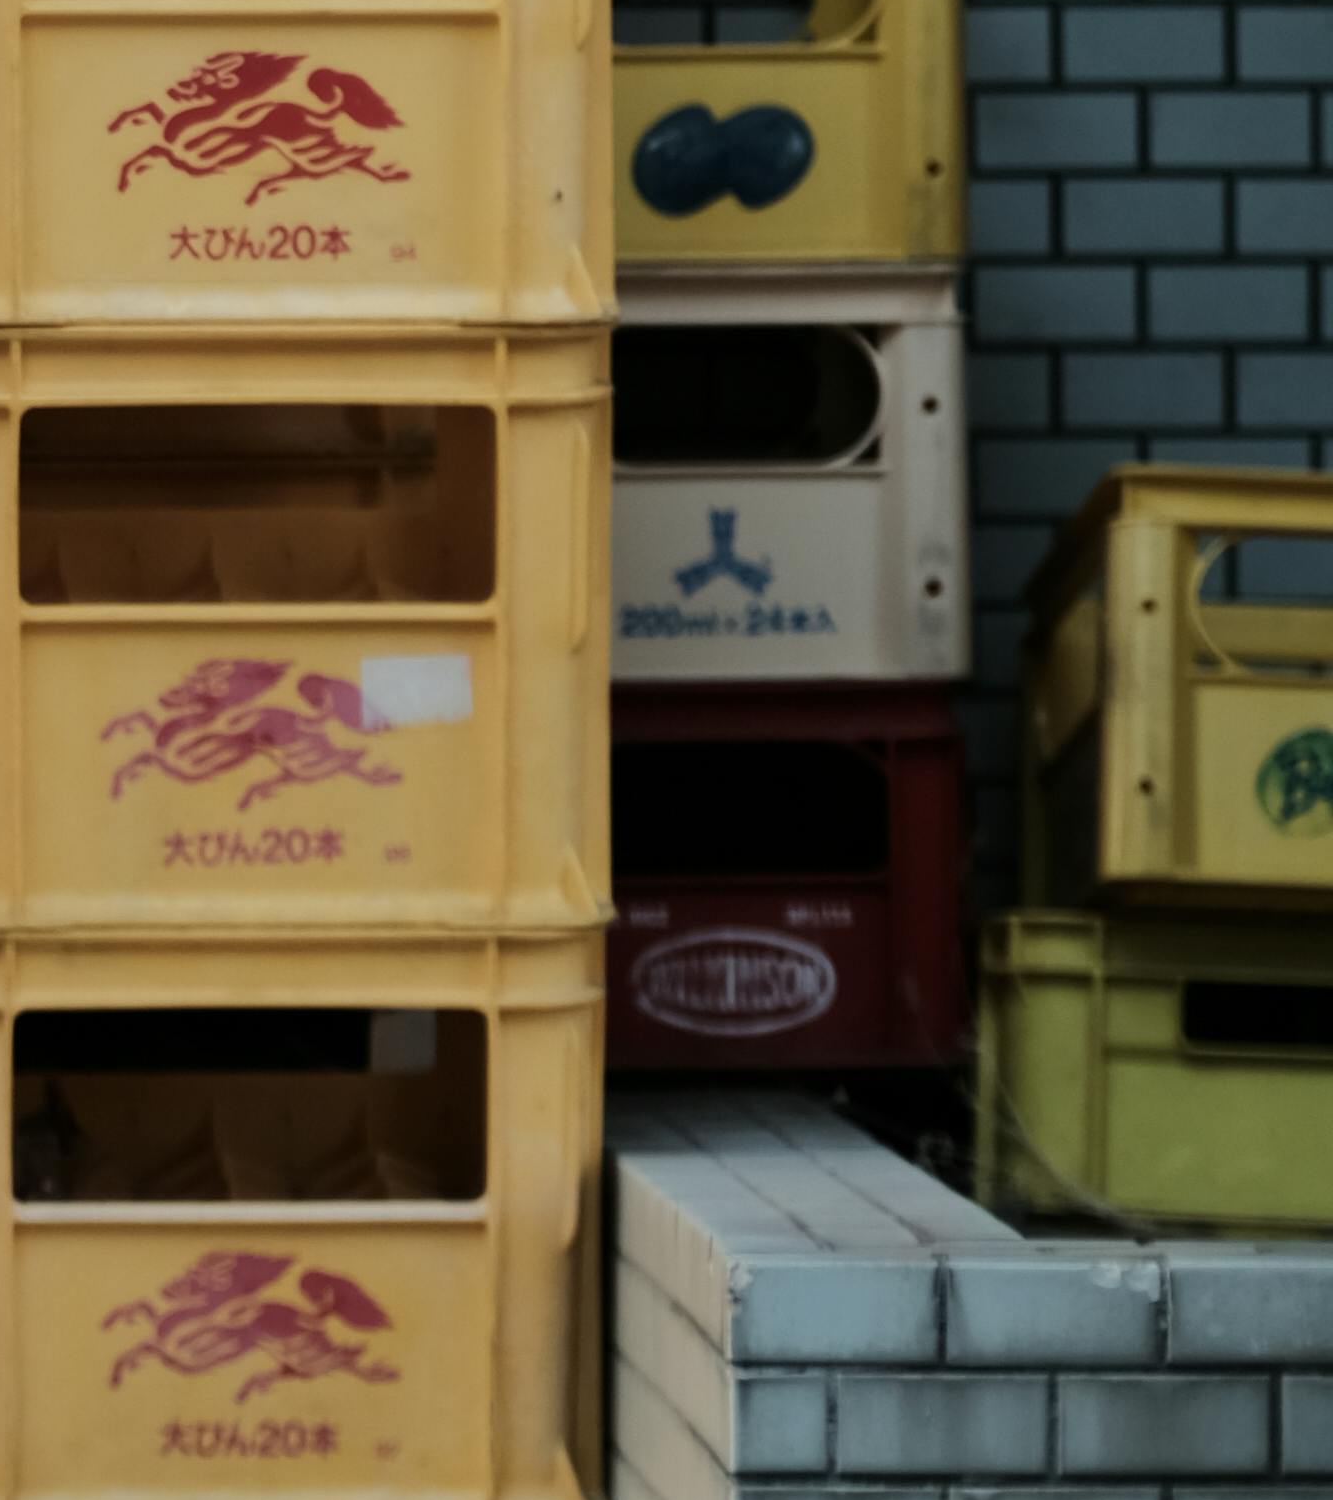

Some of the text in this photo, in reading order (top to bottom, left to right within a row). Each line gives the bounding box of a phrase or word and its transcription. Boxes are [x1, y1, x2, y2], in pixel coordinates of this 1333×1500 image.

[169, 224, 352, 262] 大びん20本
[163, 827, 344, 868] 大びん20本
